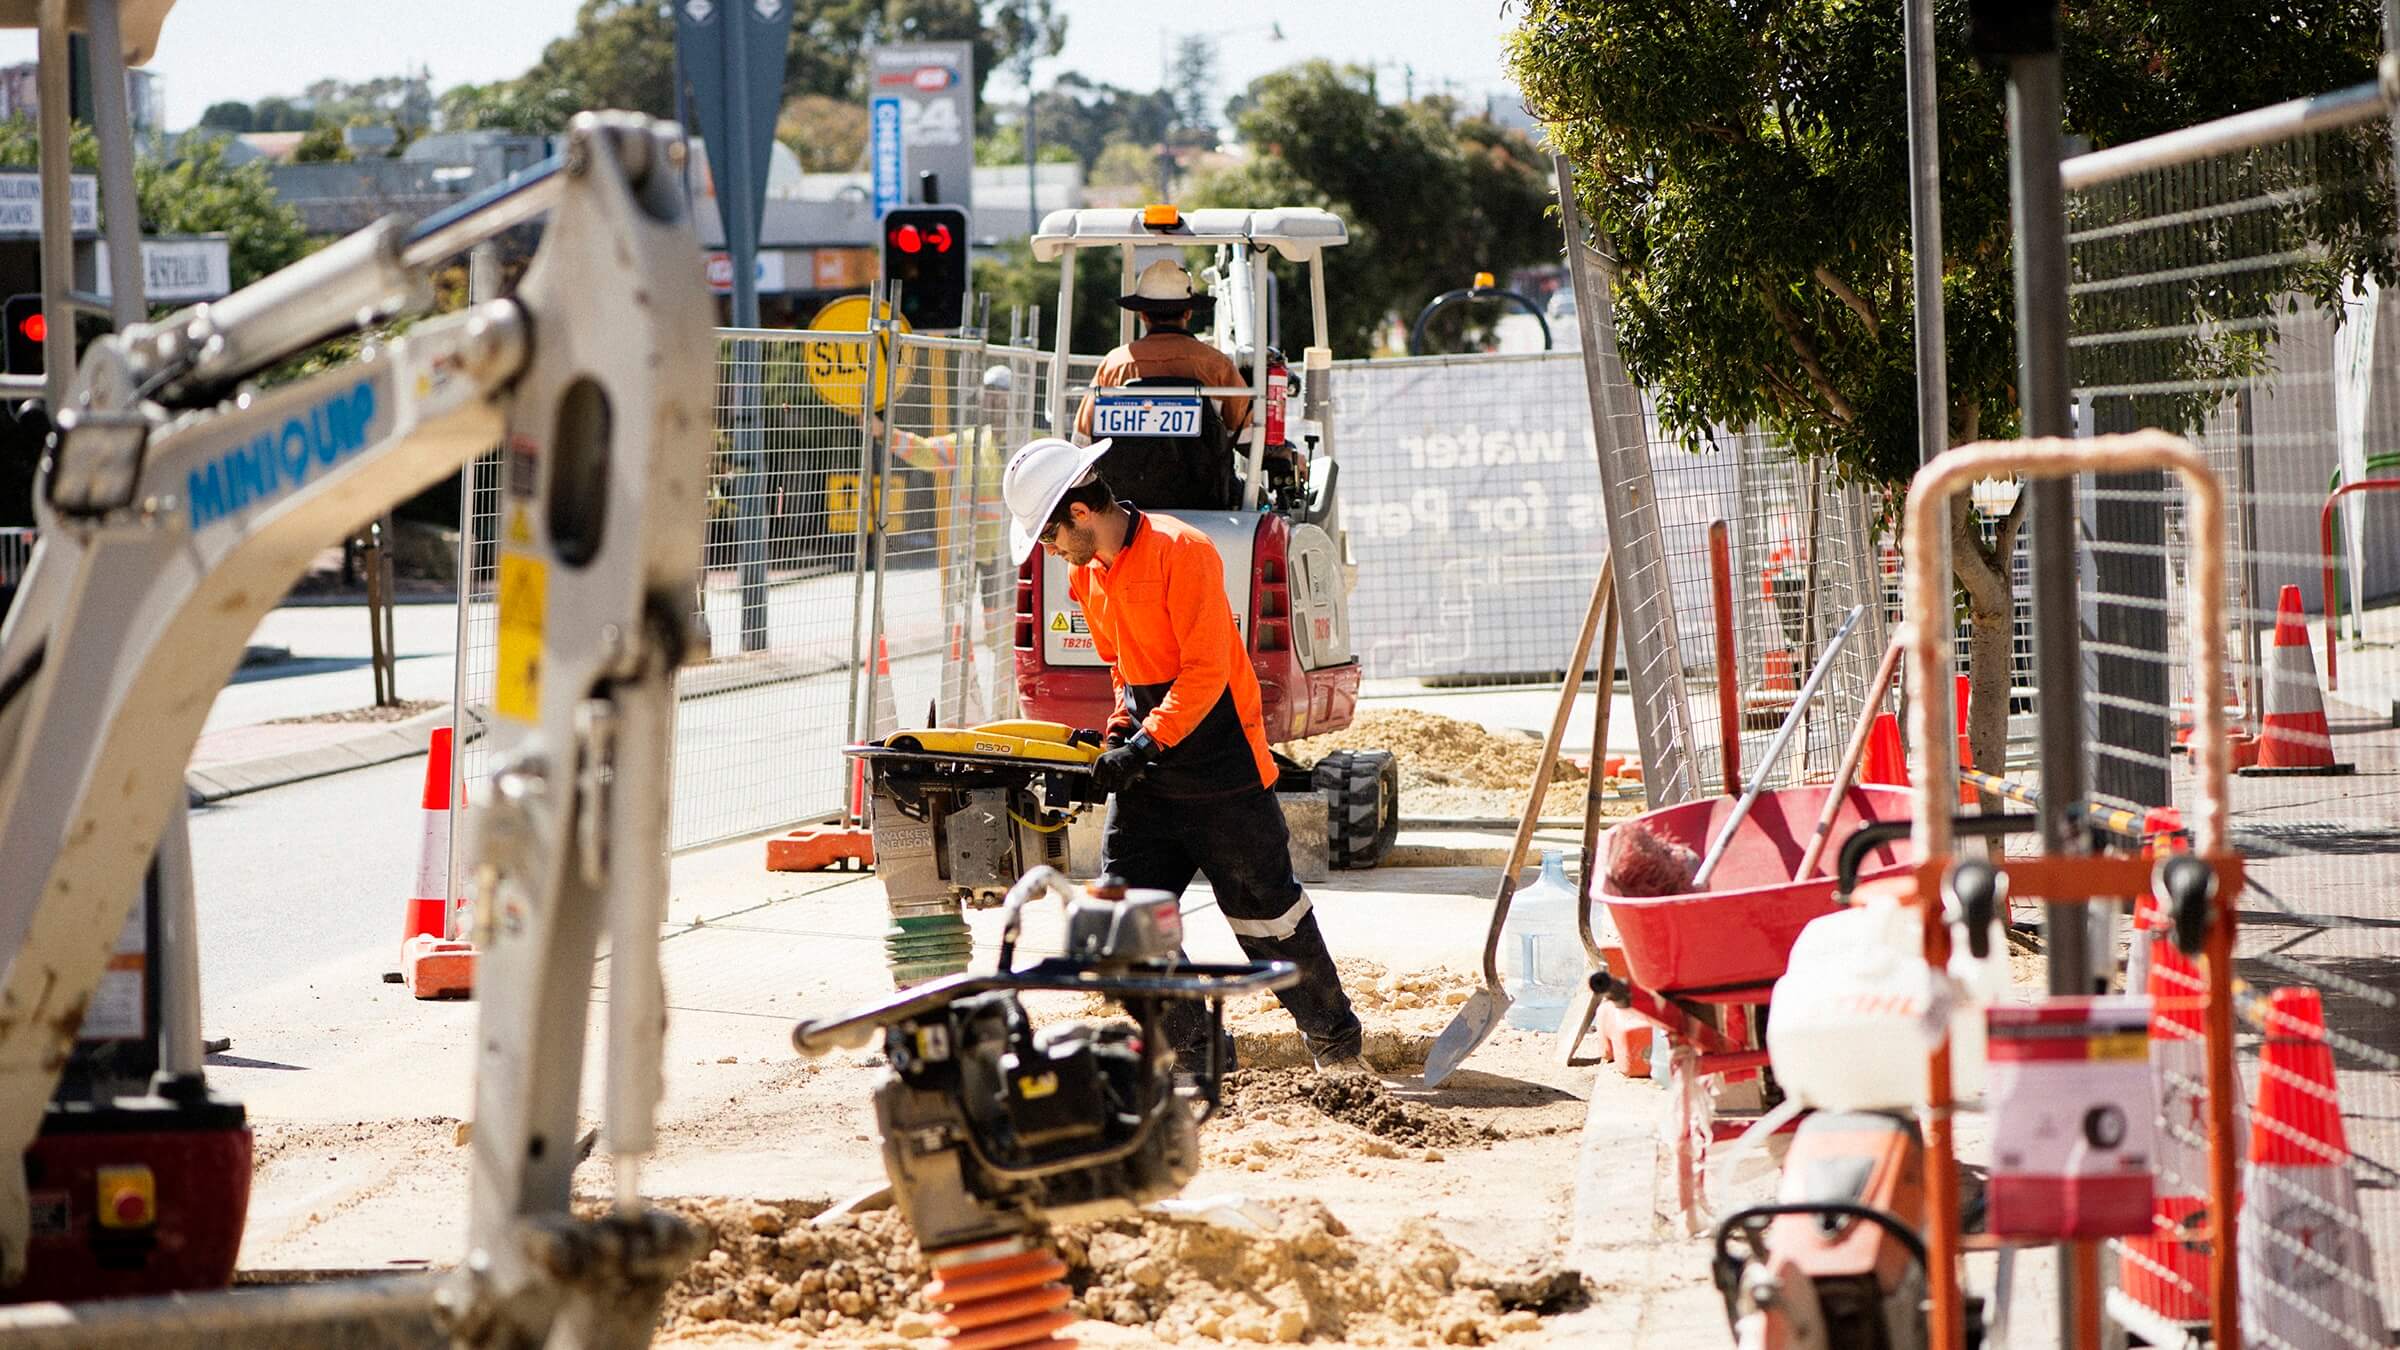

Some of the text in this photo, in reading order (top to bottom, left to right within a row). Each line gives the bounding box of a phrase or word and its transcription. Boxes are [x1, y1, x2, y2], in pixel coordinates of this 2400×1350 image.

[188, 382, 375, 531] MINIQUIP
[880, 828, 930, 841] WACKER
[880, 837, 932, 850] NEUSON
